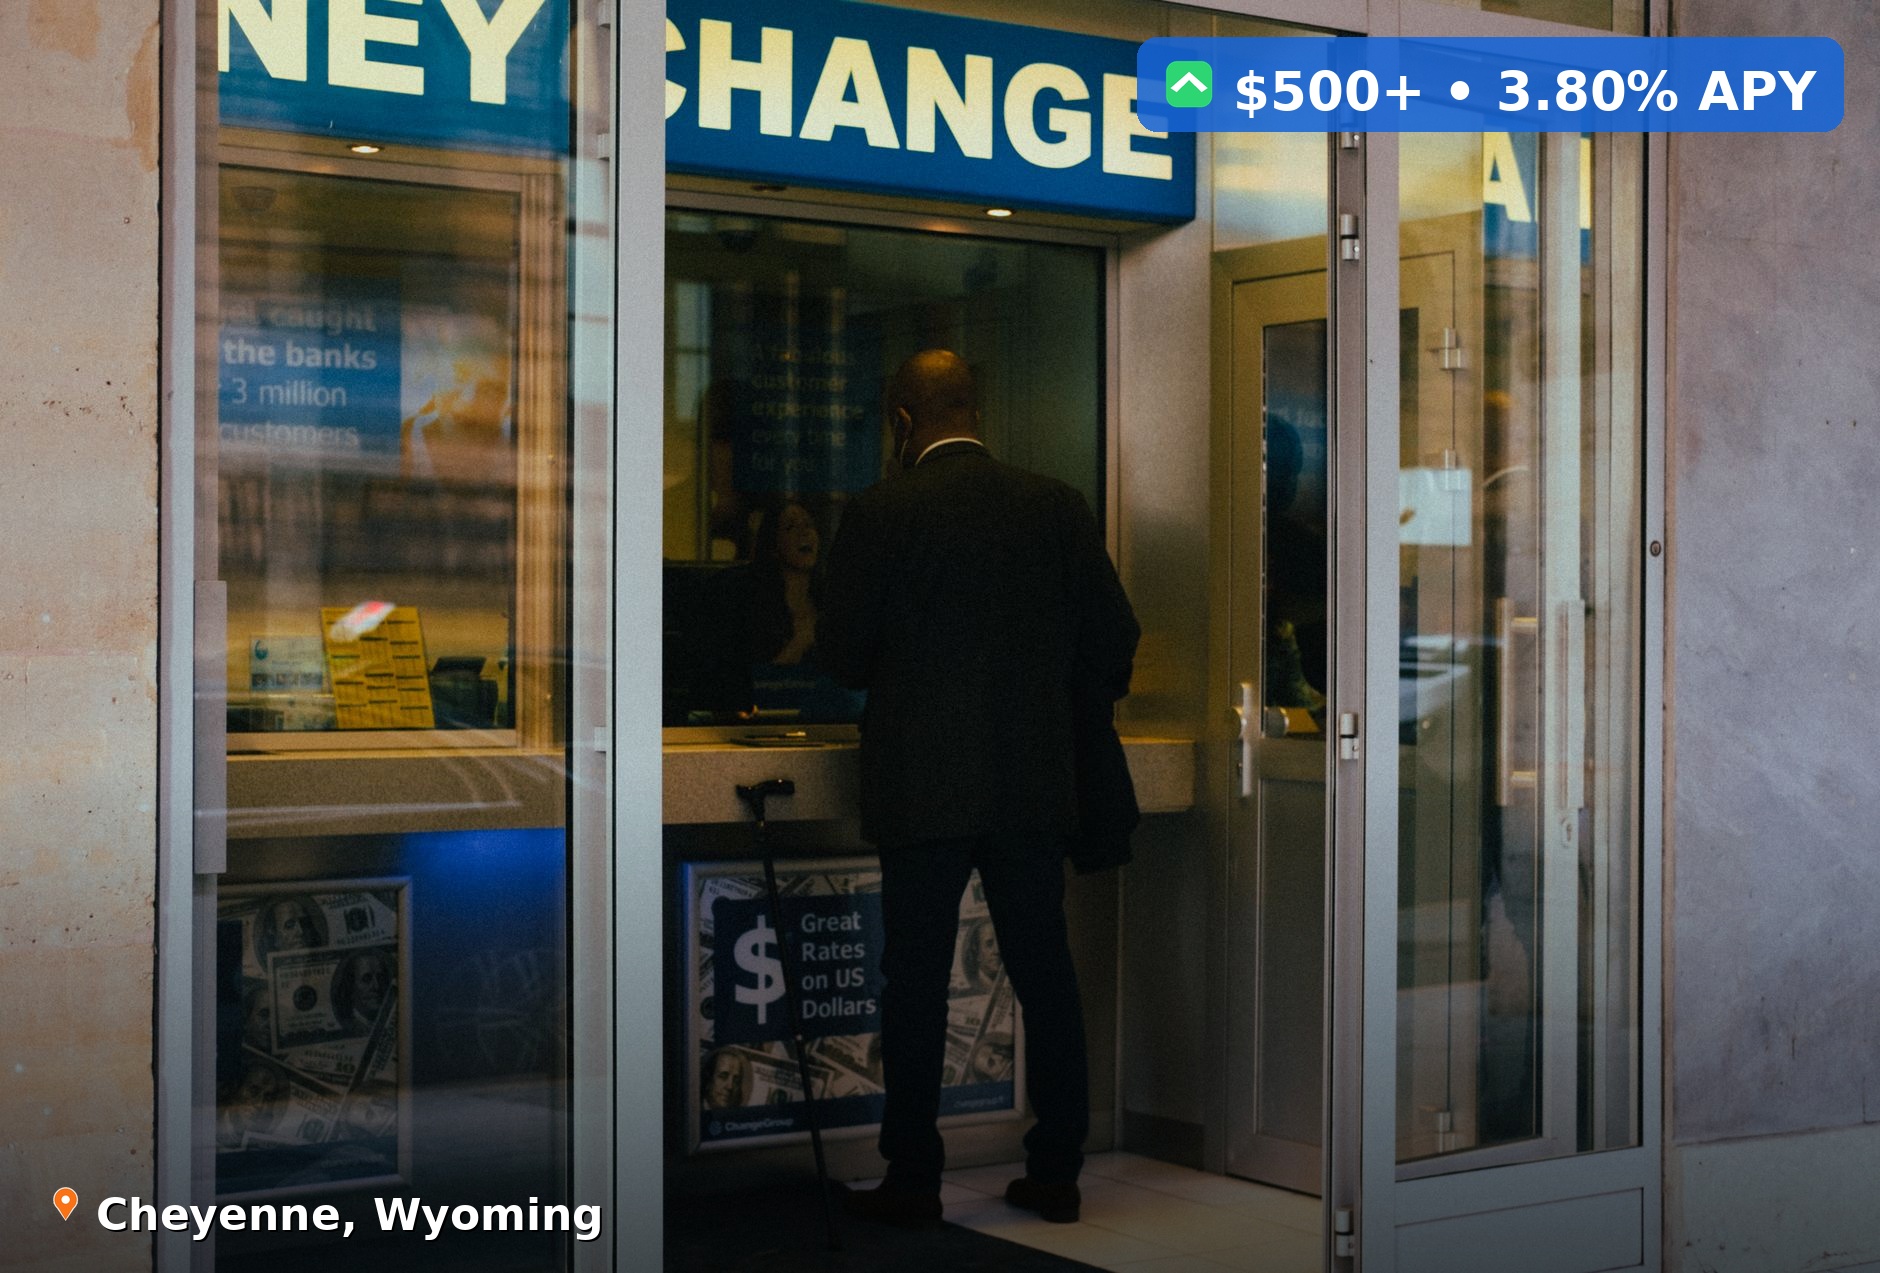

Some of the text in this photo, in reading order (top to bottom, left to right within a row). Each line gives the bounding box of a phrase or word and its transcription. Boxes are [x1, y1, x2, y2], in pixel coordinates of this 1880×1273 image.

[218, 0, 546, 105] NEY
[223, 338, 378, 371] the banks
[231, 377, 348, 408] 3 million
[219, 421, 361, 449] customers
[801, 911, 862, 933] Great
[801, 942, 865, 961] Rates
[801, 967, 865, 990] on US
[802, 997, 877, 1019] Dollars
